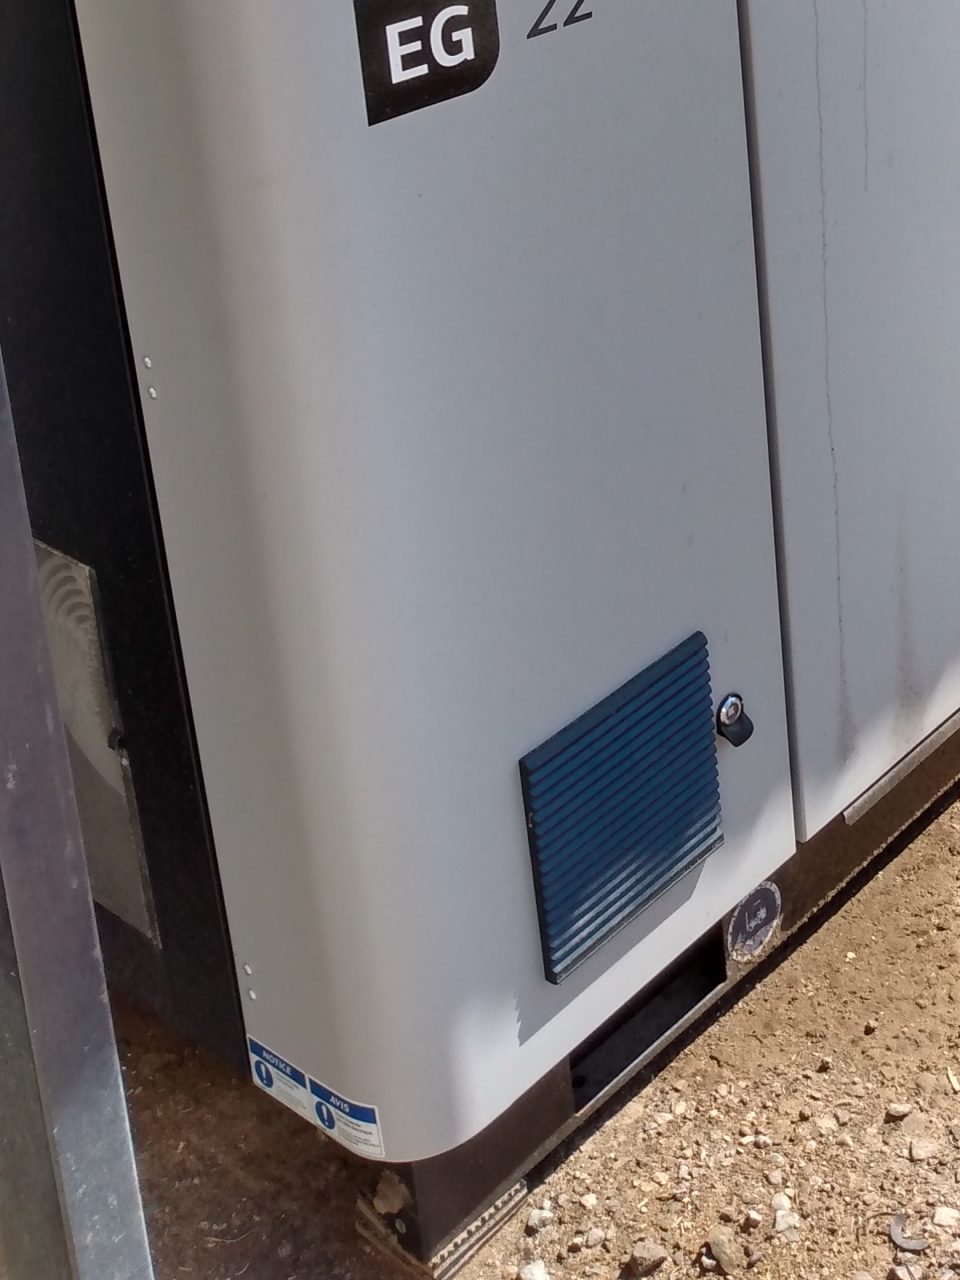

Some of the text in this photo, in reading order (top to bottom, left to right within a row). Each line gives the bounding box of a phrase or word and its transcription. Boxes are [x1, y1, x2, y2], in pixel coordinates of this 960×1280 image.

[385, 4, 475, 85] EG
[261, 1049, 293, 1076] NOTICE
[329, 1095, 350, 1114] AVIS
